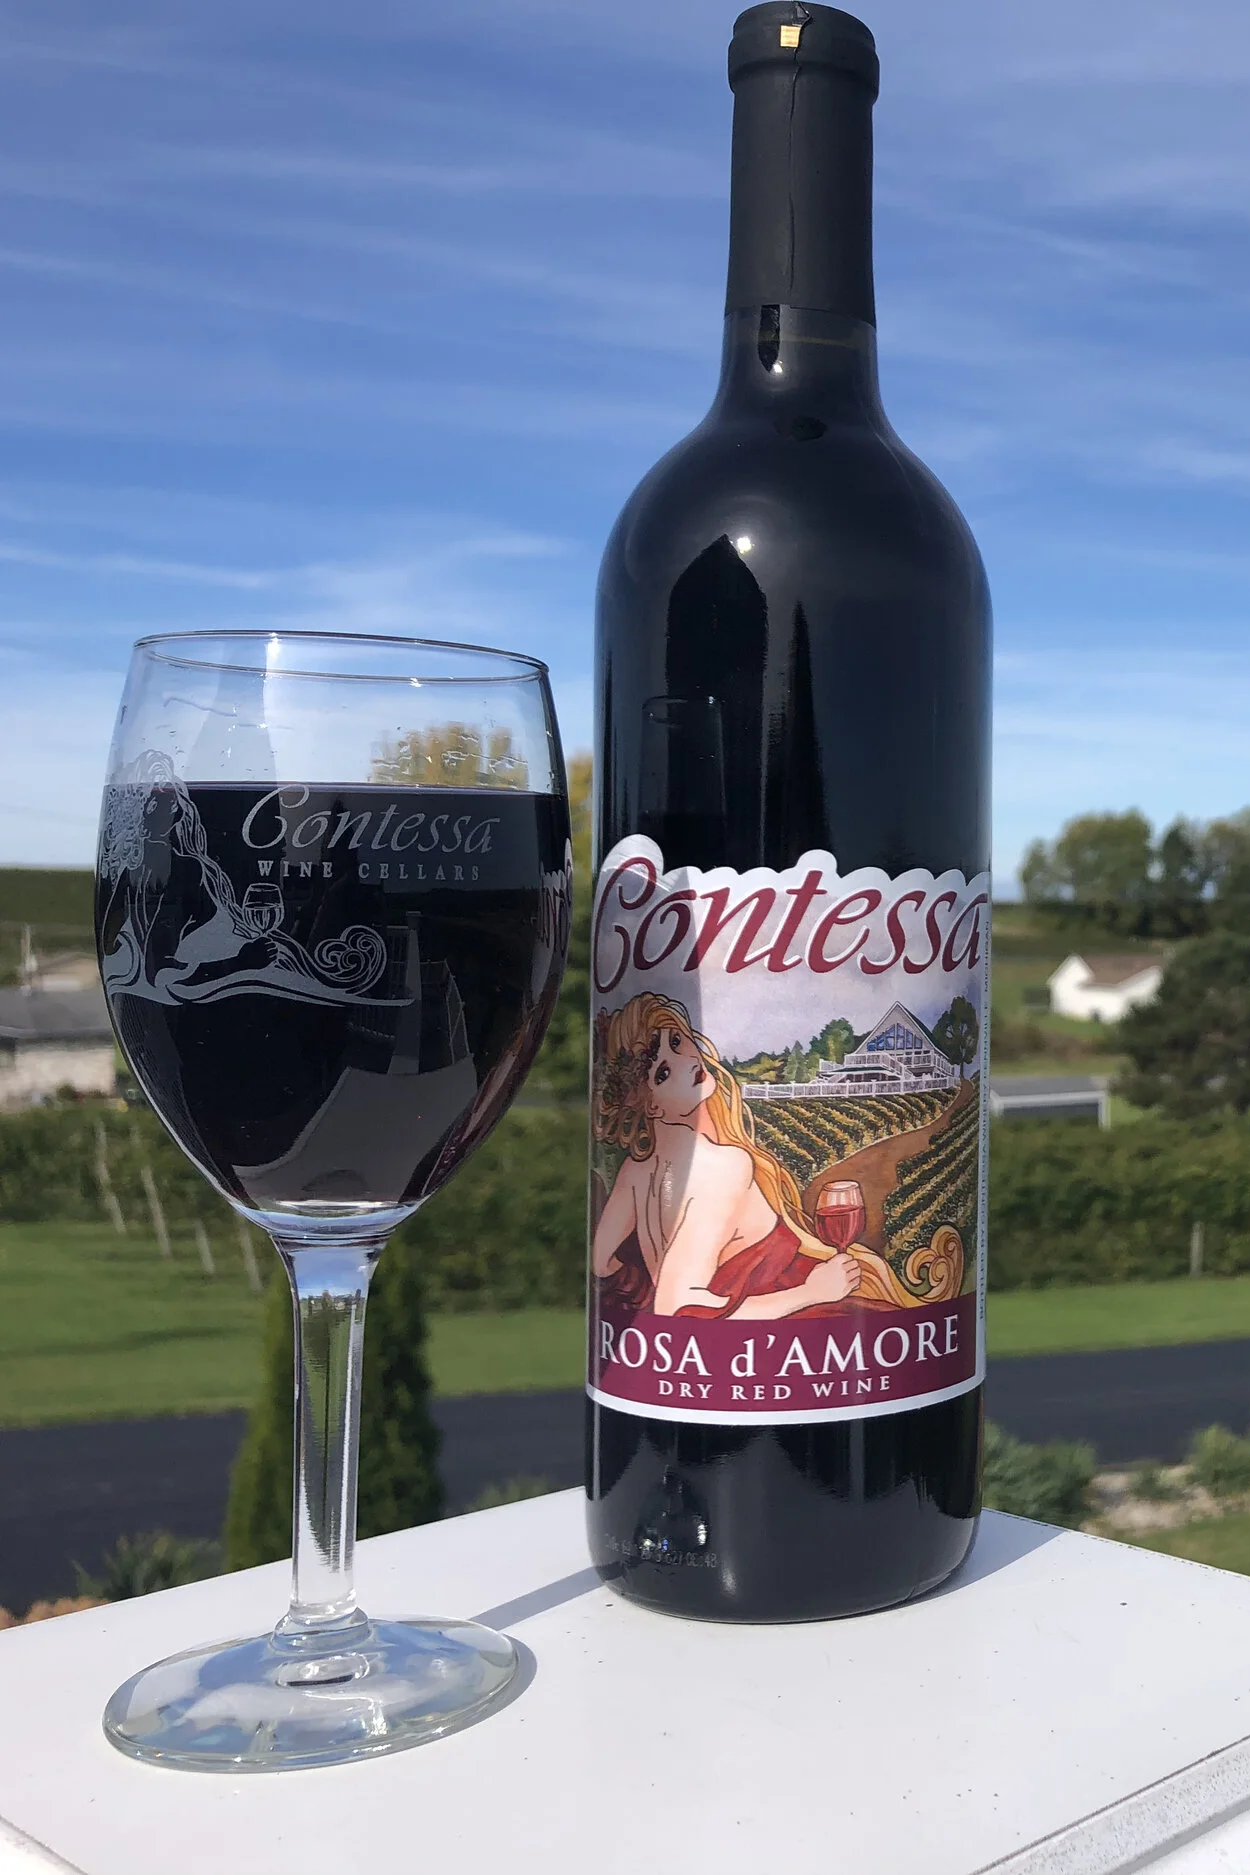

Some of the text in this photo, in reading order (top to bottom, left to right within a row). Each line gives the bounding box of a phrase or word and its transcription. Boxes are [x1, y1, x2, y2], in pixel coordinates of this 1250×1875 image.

[242, 784, 500, 853] Contessa
[258, 860, 481, 881] WINE CELLARS
[593, 856, 988, 993] Contessa
[599, 1319, 711, 1376] ROSA
[658, 1375, 891, 1401] DRY RED WINE
